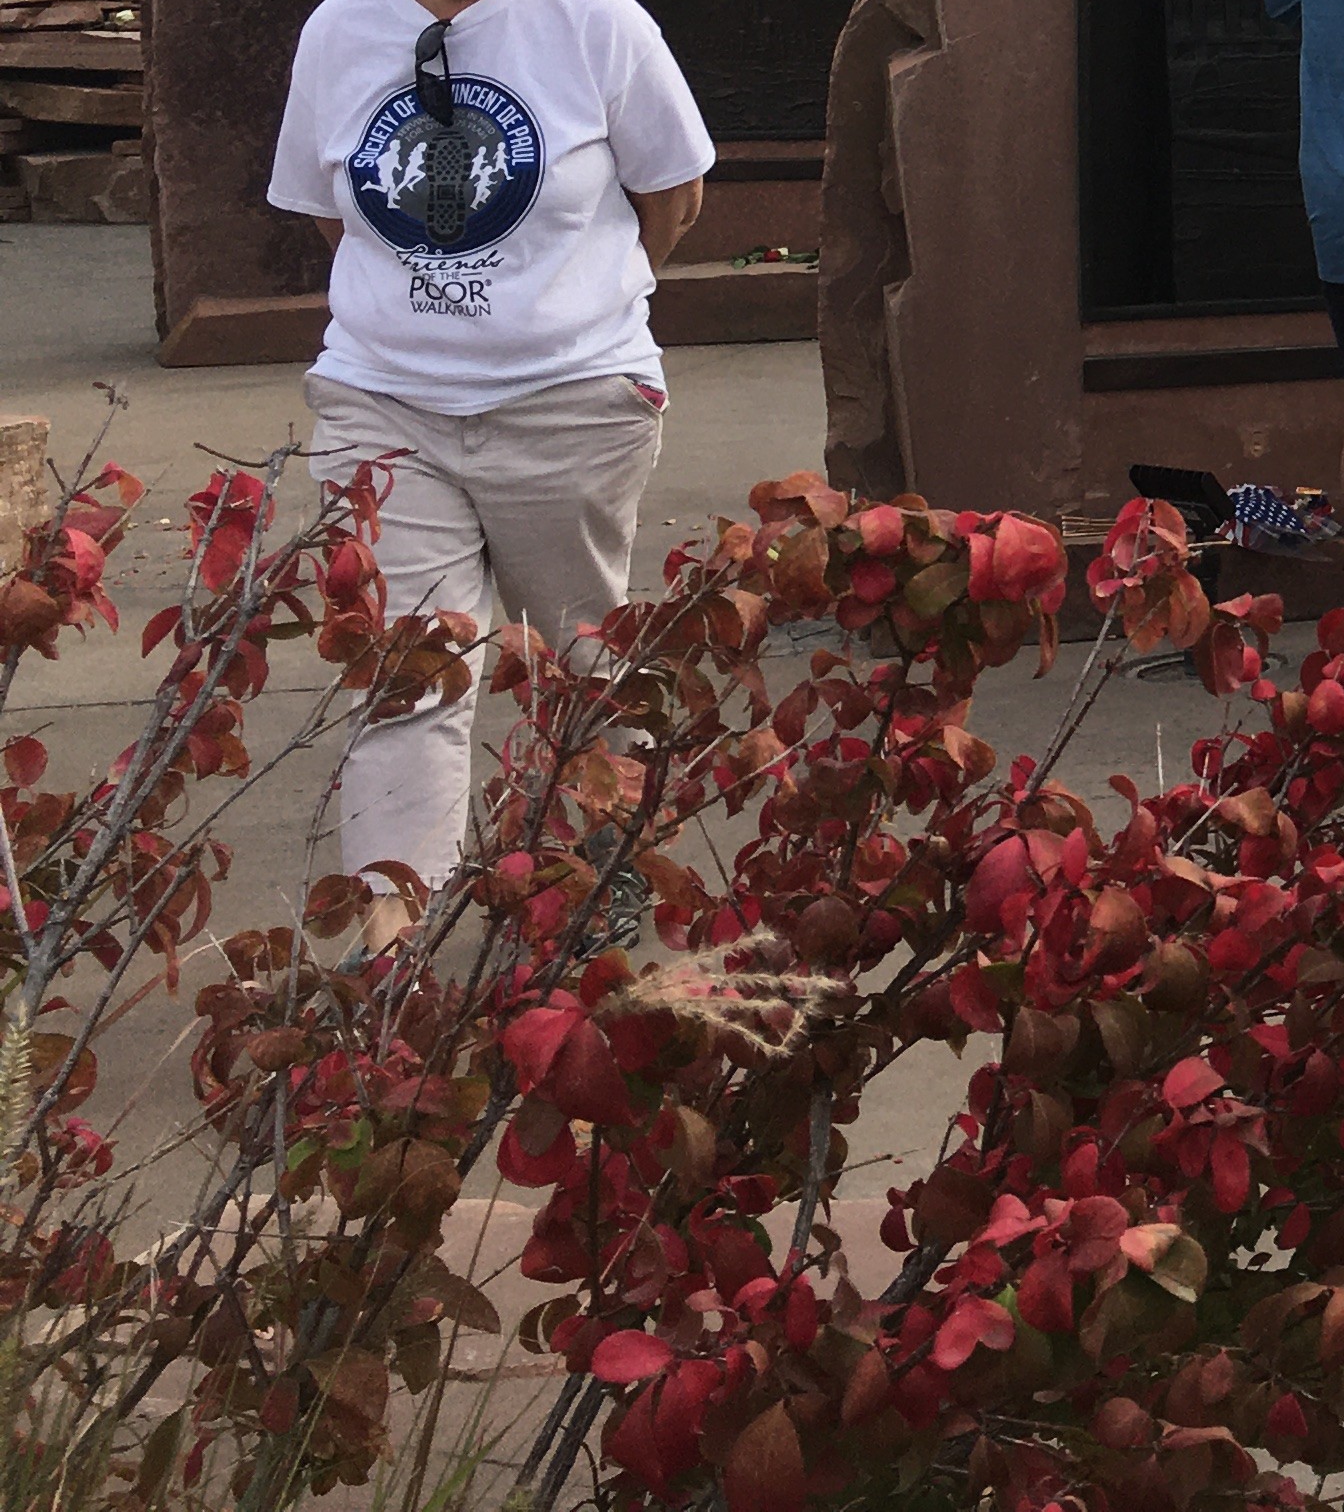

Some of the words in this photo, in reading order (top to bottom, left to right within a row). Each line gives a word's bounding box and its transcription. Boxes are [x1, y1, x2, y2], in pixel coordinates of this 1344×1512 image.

[392, 94, 416, 118] OF
[496, 104, 524, 131] DE
[353, 110, 399, 168] SOCIETY
[506, 125, 535, 166] PAUL
[396, 244, 505, 272] Friends
[423, 272, 435, 281] OF
[440, 271, 460, 280] THE
